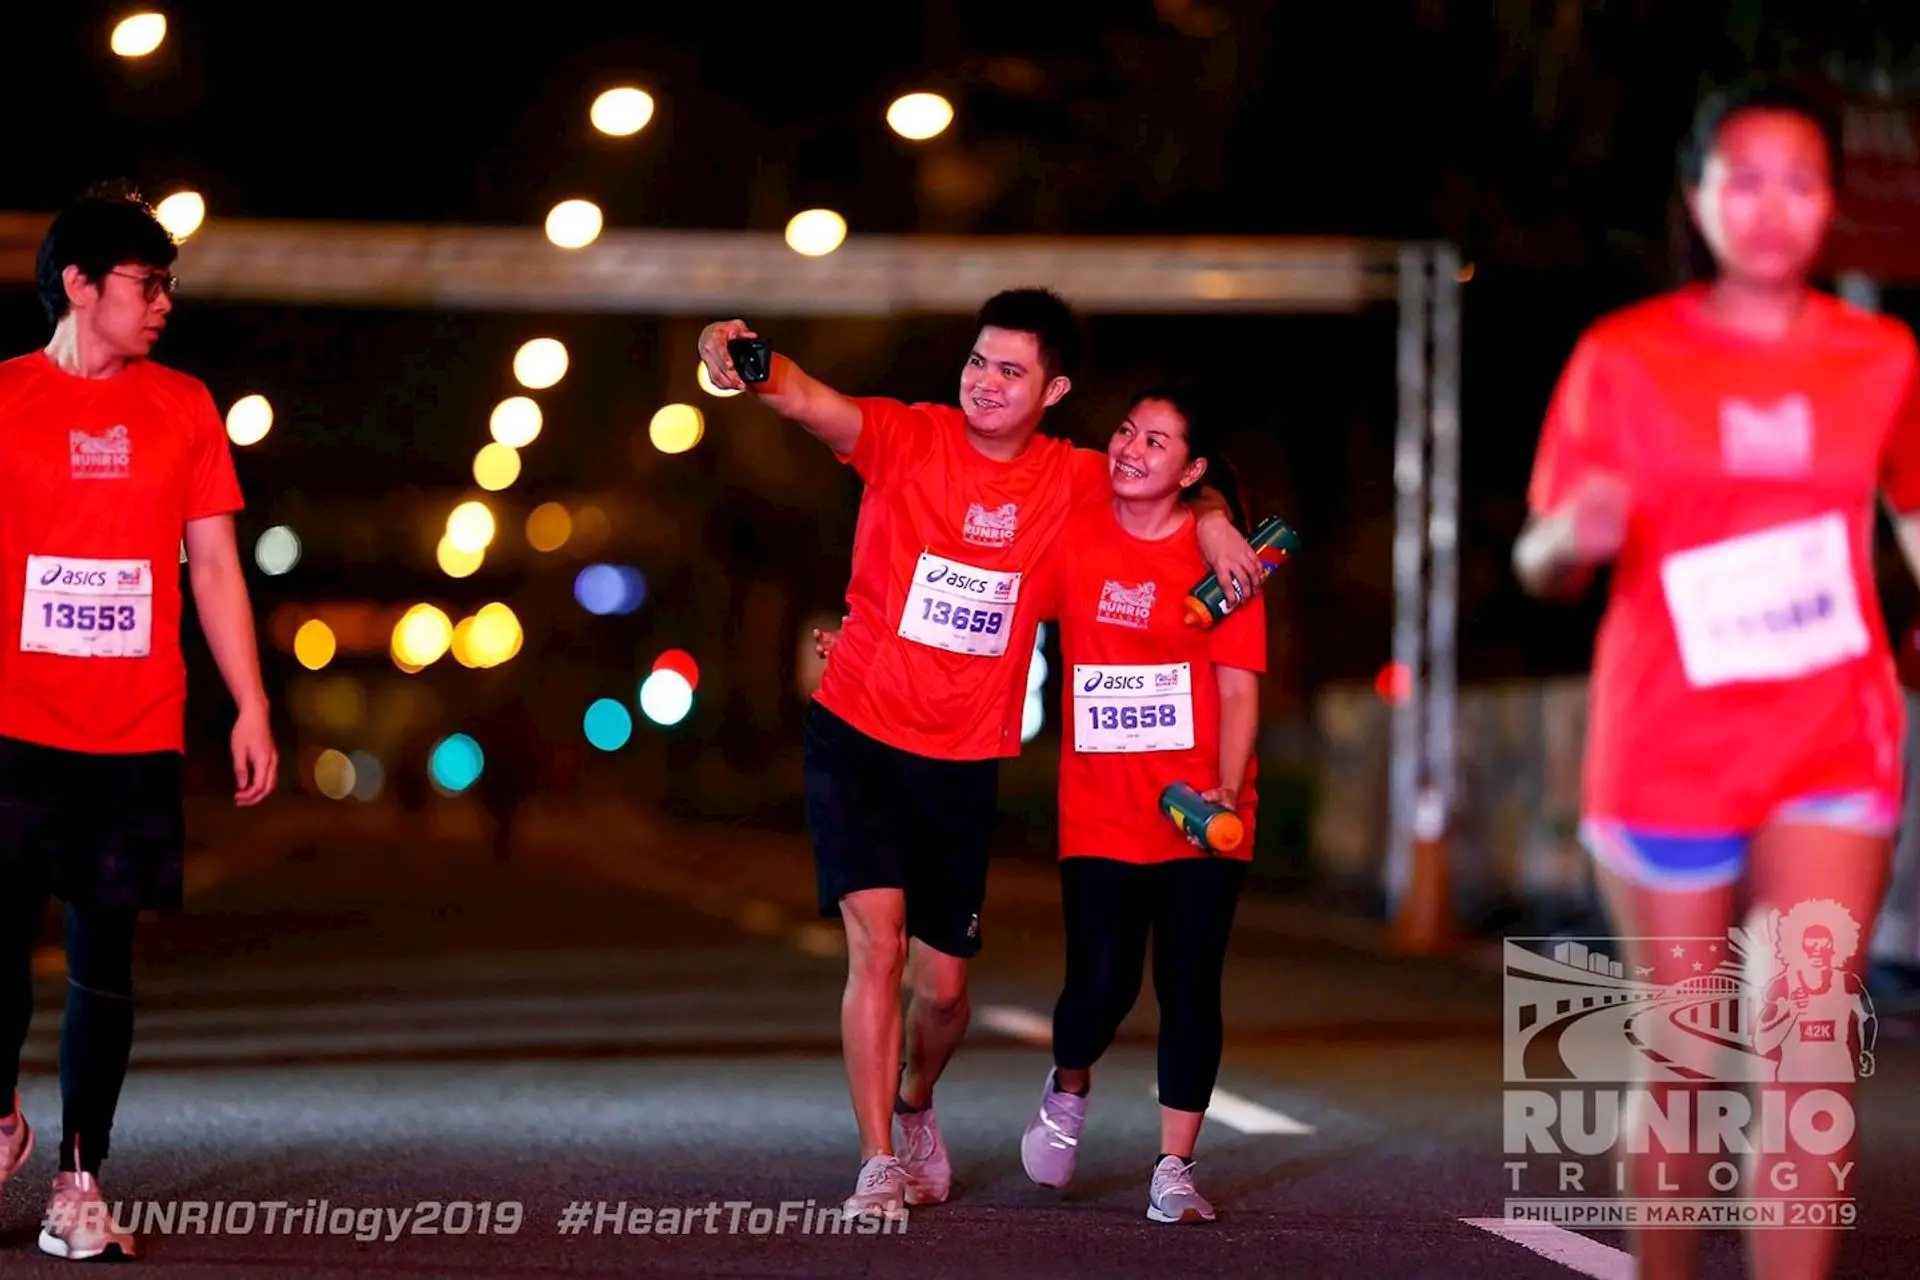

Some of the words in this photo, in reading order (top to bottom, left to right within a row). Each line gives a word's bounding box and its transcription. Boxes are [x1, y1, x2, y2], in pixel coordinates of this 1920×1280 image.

[42, 602, 136, 632] 13553
[921, 597, 1003, 635] 13659
[1098, 600, 1150, 619] RUNRIO
[1088, 703, 1177, 730] 13658
